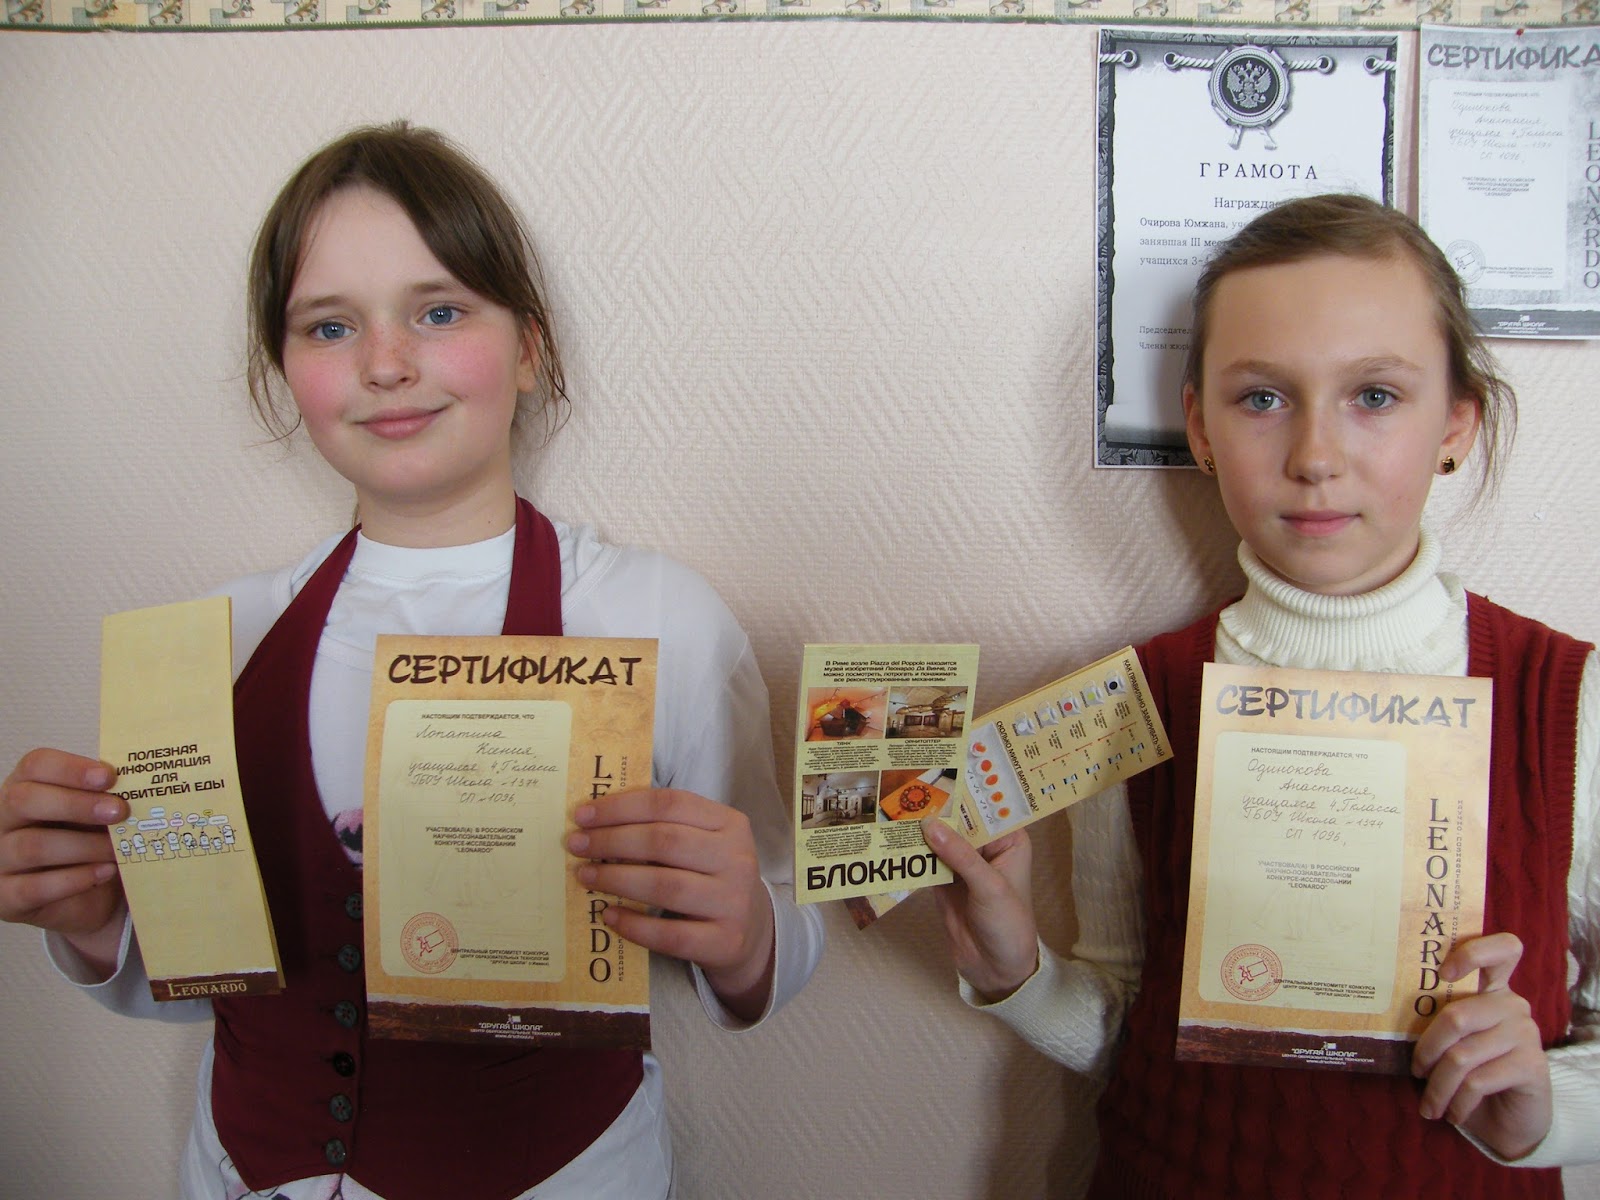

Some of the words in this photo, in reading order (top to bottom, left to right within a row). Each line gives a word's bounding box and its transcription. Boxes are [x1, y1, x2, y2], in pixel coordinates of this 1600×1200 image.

[1200, 163, 1318, 179] ГРАМОТА
[1140, 217, 1181, 230] Очирова
[1140, 238, 1187, 247] занявшая
[1190, 238, 1200, 247] III
[1140, 256, 1188, 267] учащихся
[388, 655, 642, 685] СЕРТИФИКАТ
[1215, 684, 1476, 728] СЕРТИФИКАТ
[128, 744, 198, 762] ПОЛЕЗНАЯ
[1251, 747, 1292, 756] НАСТОЯЩИМ
[1355, 752, 1369, 760] ЧТО
[117, 755, 211, 776] ИНФОРМАЦИЯ
[1247, 758, 1333, 782] Одинокова
[151, 772, 179, 785] ДЛЯ
[195, 779, 225, 791] ЕДЫ
[807, 853, 938, 890] БЛОКНОТ
[1265, 867, 1352, 879] НАУЧНО-ПОЗНАВАТЕЛЬНОМ
[1316, 863, 1360, 873] РОССИЙСКОМ
[1266, 874, 1352, 886] КОНКУРСЕ-ИССЛЕДОВАНИИ
[1288, 882, 1328, 890] "LEONARDO"
[1414, 798, 1449, 1018] LEONARDO
[167, 982, 247, 997] LEONARDO
